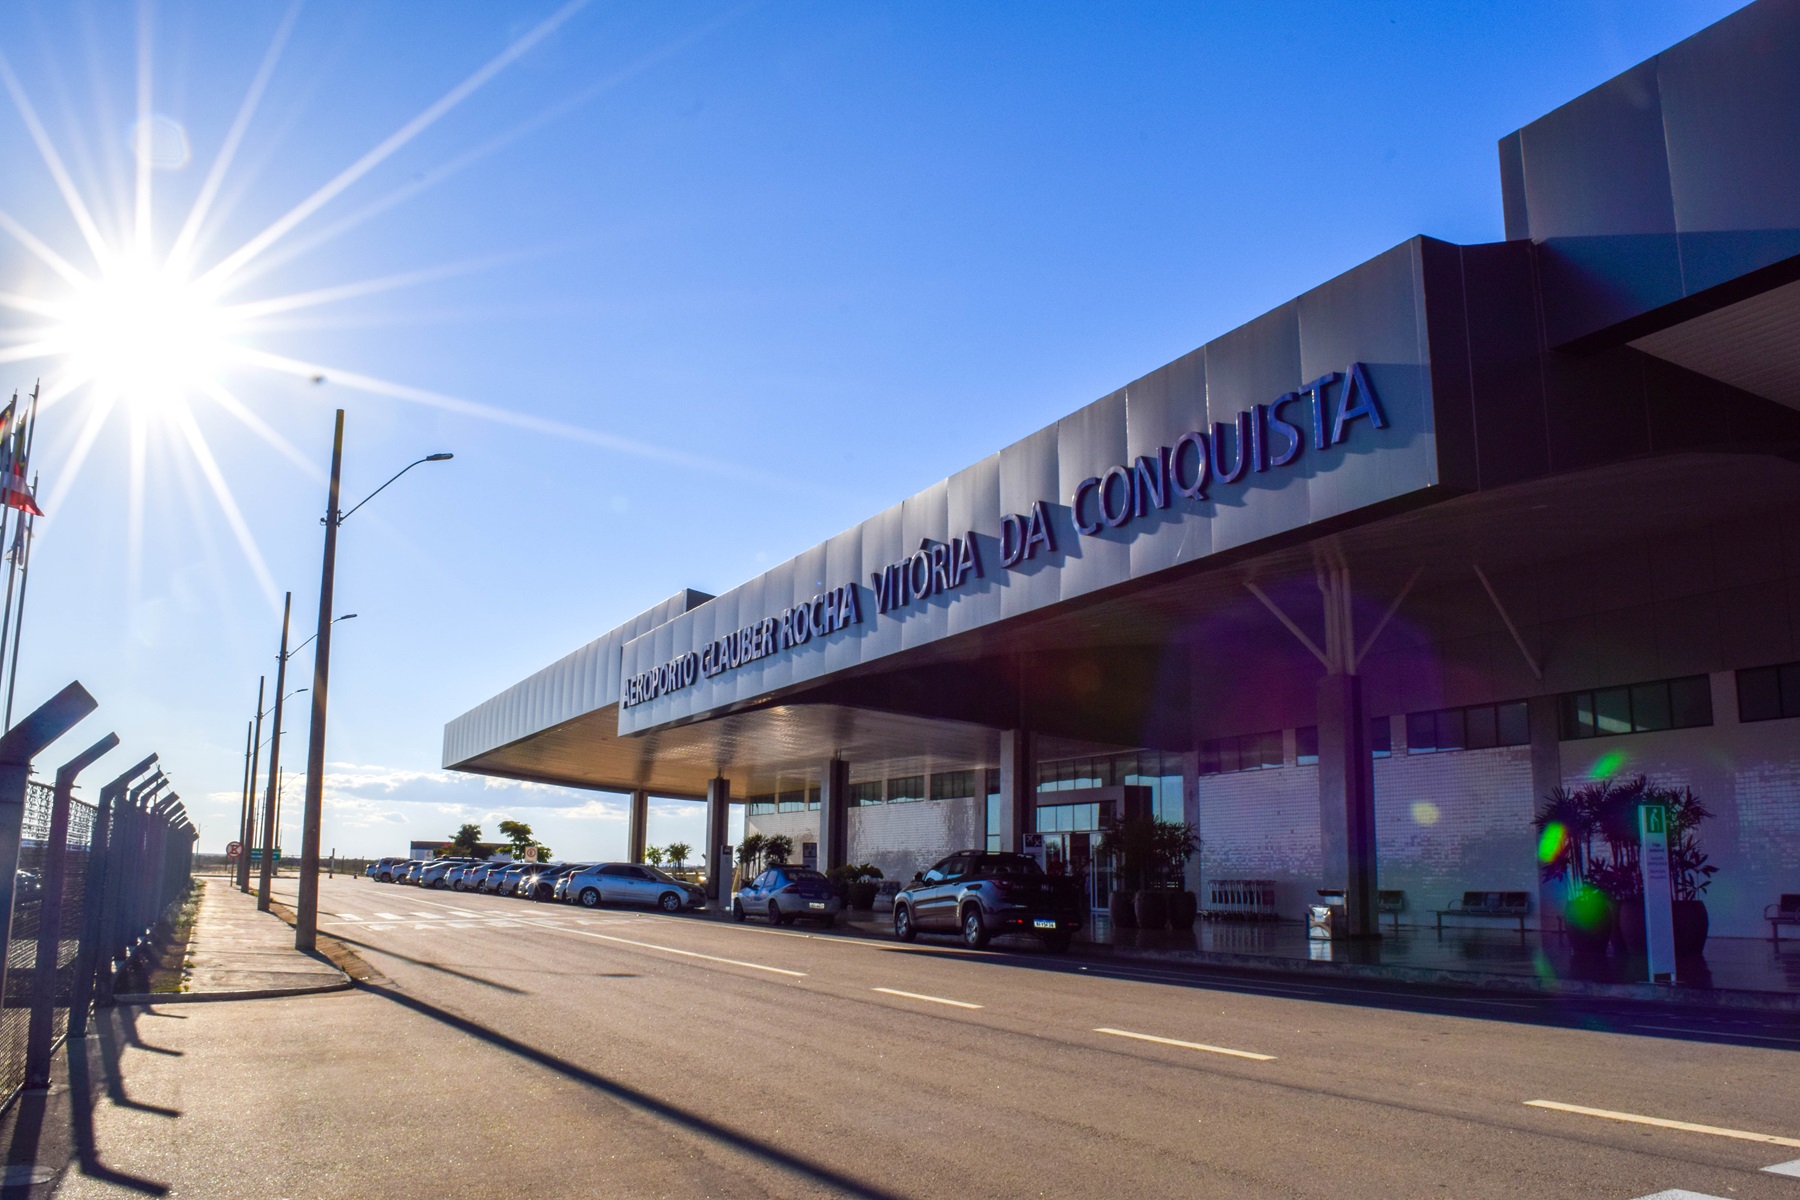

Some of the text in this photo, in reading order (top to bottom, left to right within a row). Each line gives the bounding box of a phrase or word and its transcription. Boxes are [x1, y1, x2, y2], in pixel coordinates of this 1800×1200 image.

[622, 361, 1388, 709] AEROPORTO GLAUBER ROCHA VITÓRIA DA CONQUISTA
